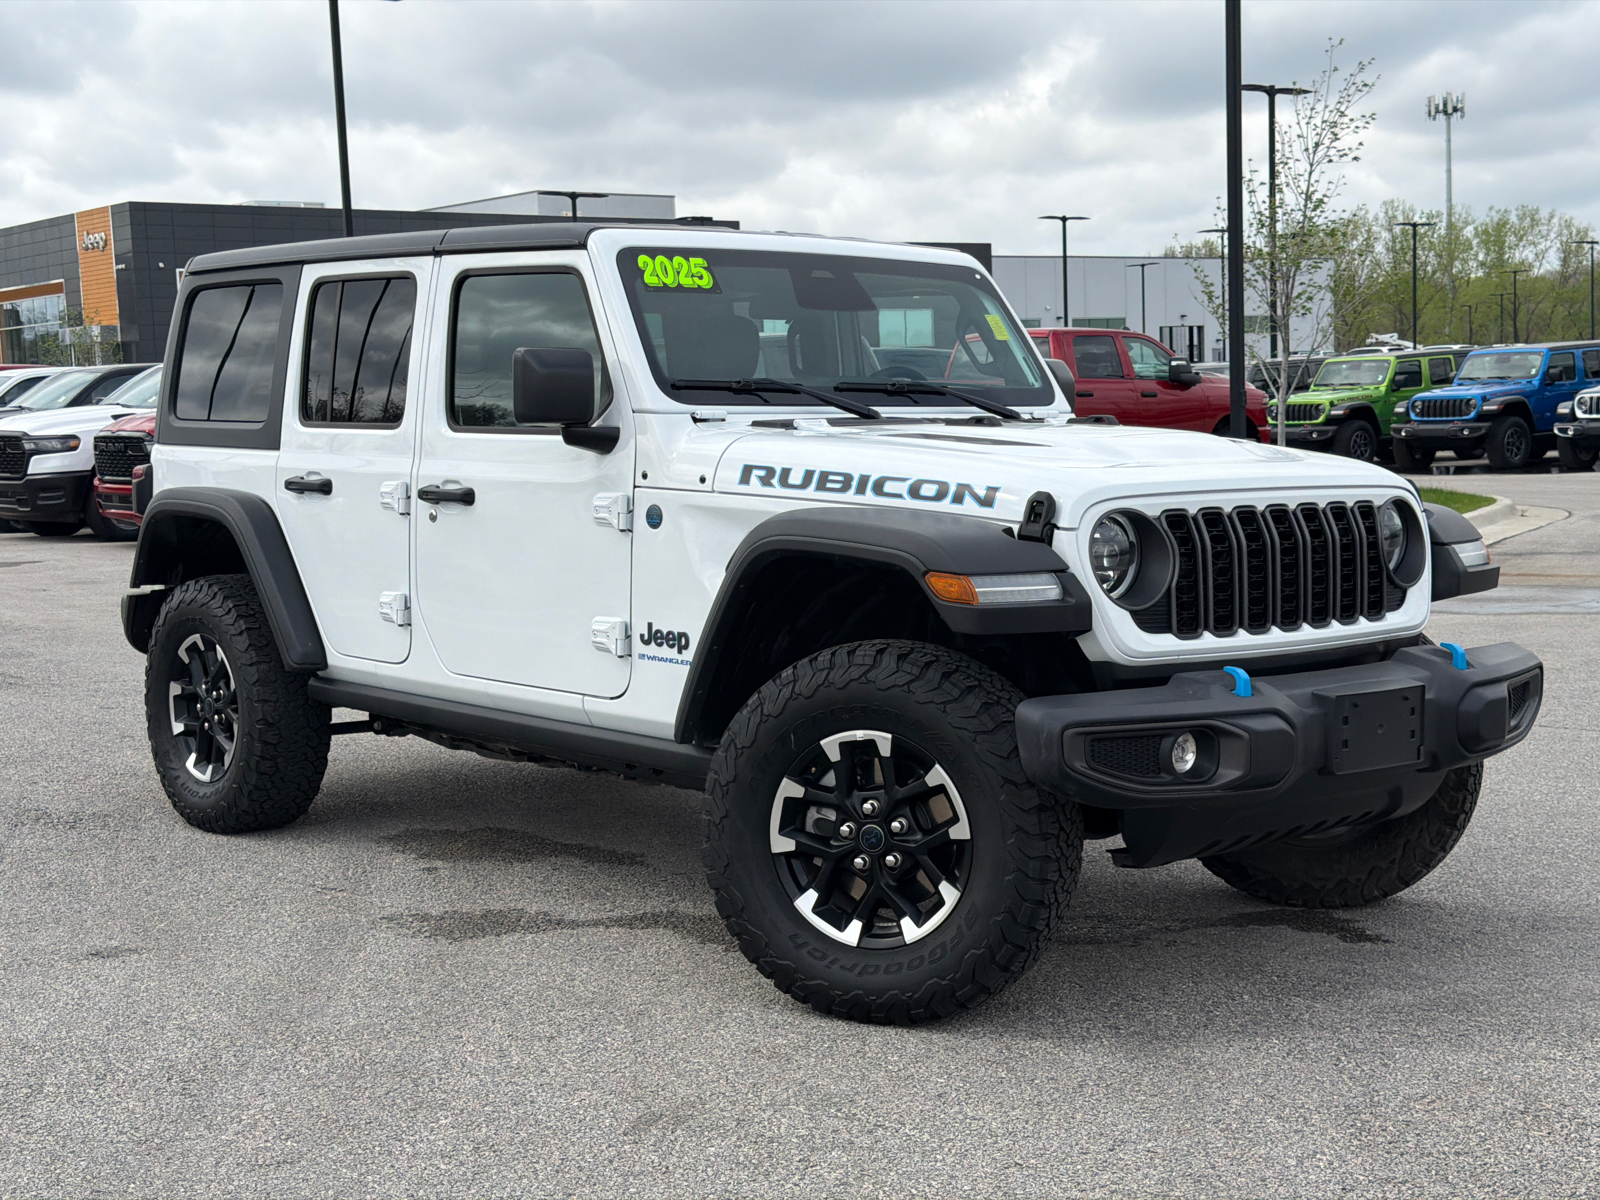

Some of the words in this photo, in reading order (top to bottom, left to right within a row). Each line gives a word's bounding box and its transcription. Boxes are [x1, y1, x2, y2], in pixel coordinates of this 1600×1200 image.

[82, 230, 107, 252] Jeep
[637, 254, 713, 289] 2025
[738, 463, 1001, 509] RUBICON
[639, 621, 690, 655] Jeep
[646, 654, 692, 667] WRANGLER
[787, 901, 982, 978] BFGoodrich
